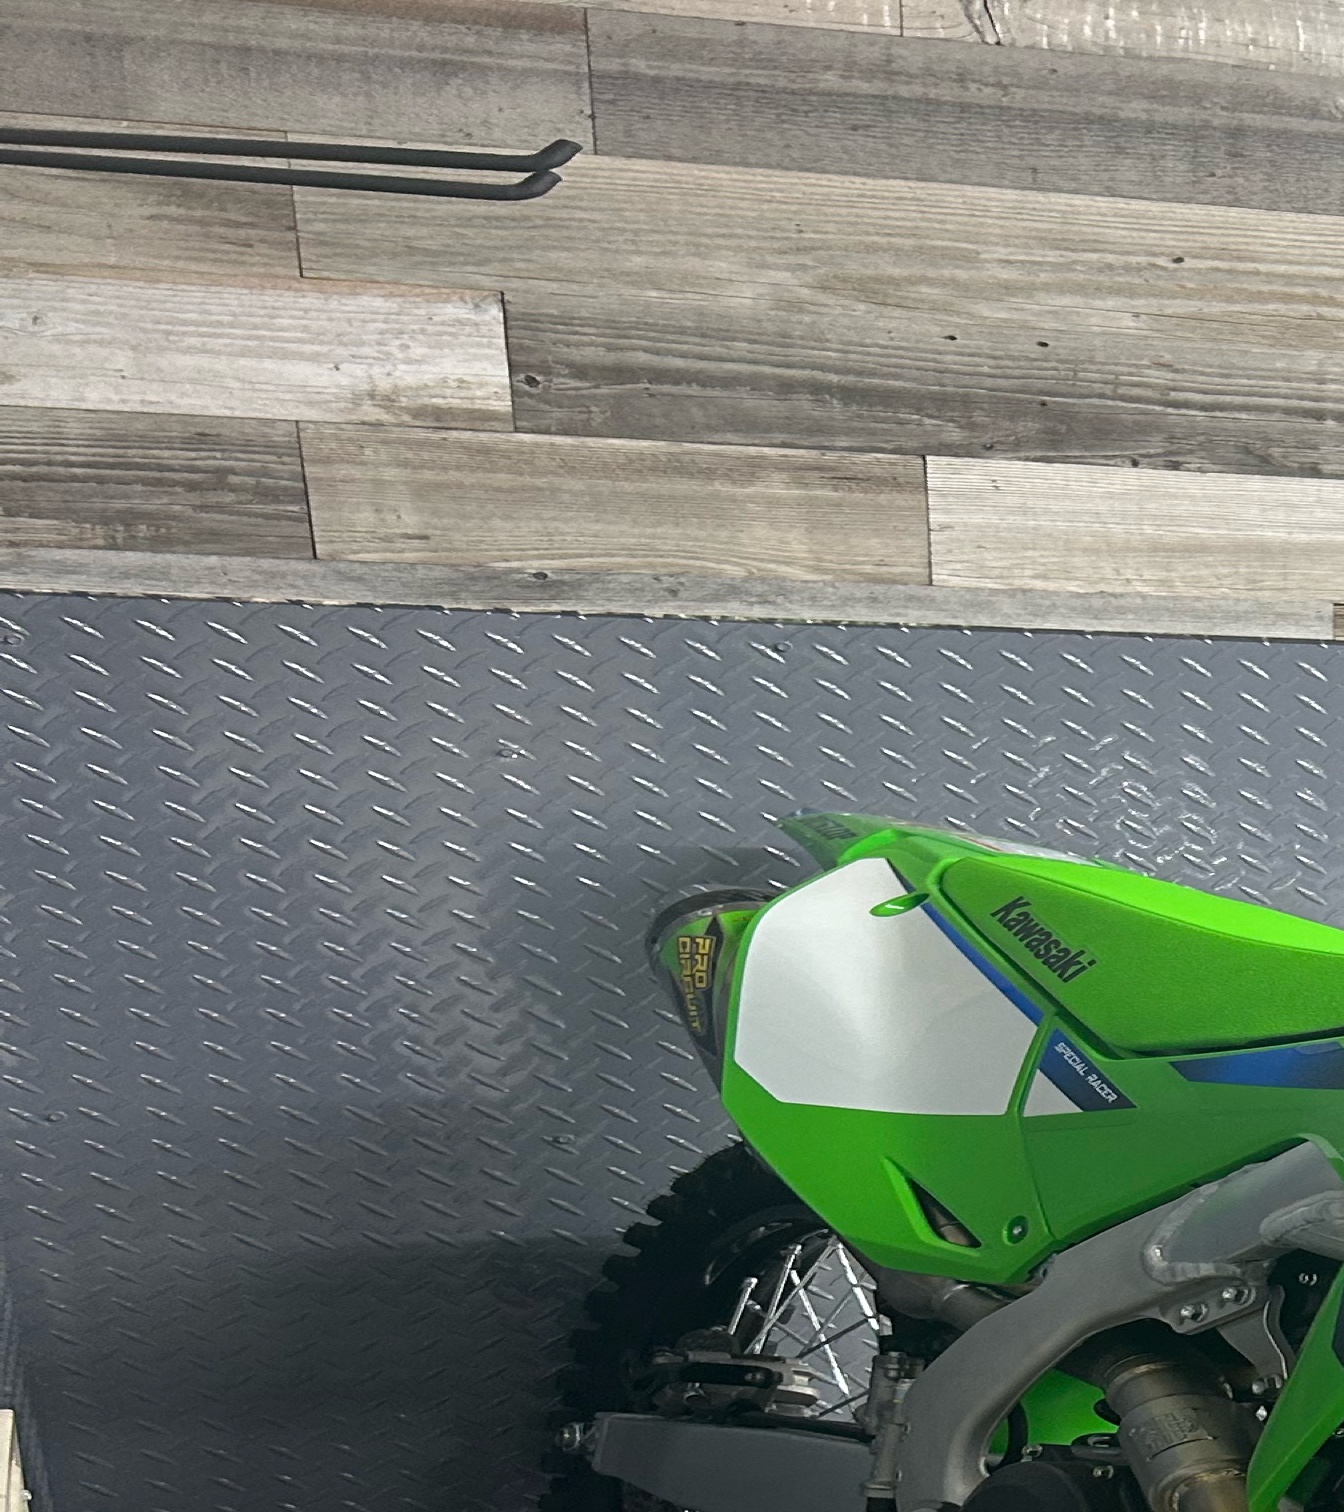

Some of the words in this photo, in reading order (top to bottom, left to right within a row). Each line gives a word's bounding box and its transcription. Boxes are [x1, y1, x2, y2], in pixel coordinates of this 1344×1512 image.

[692, 937, 711, 988] PRO
[989, 896, 1097, 983] Kawasaki
[1054, 1042, 1087, 1077] SPECIAL
[1085, 1073, 1119, 1103] RACER
